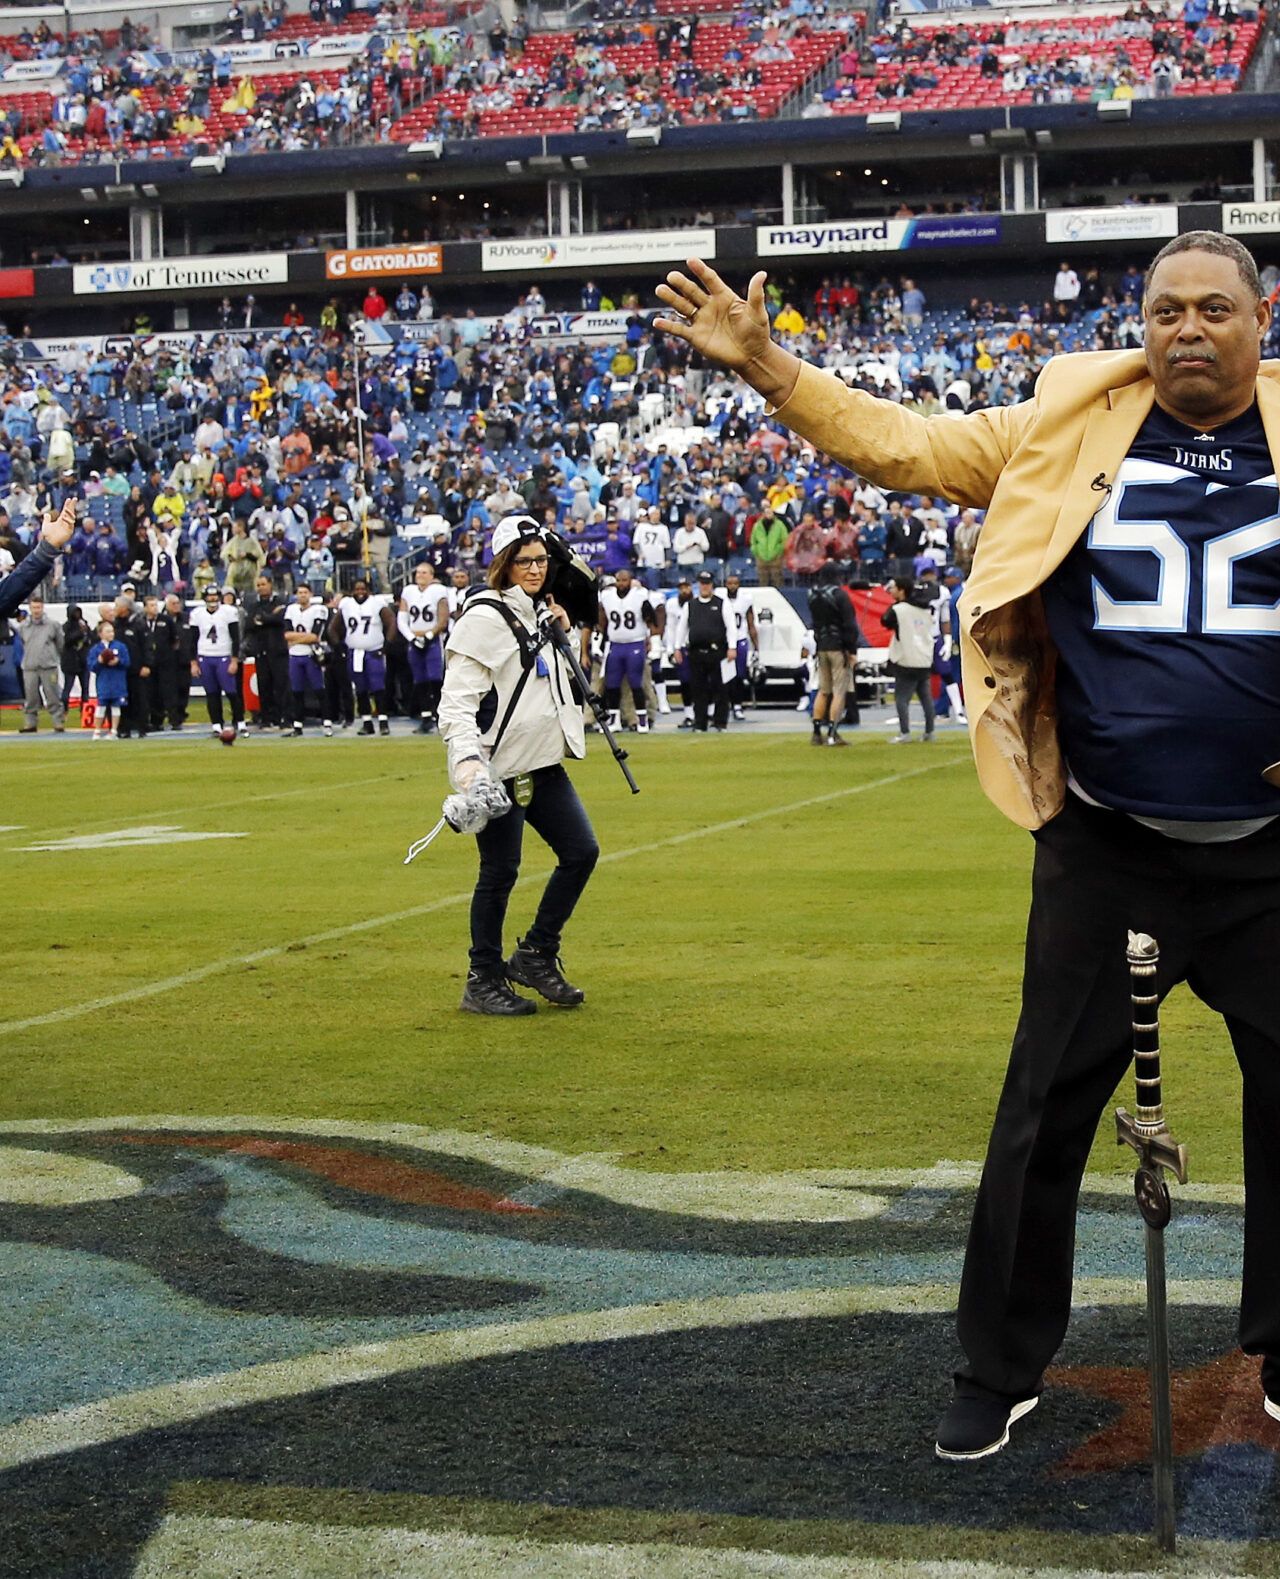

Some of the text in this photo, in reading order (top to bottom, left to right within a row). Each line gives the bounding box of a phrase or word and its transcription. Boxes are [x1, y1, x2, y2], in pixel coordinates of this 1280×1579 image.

[769, 220, 888, 257] maynard
[489, 242, 548, 258] RJYoung
[328, 251, 439, 276] G GATORADE
[132, 264, 270, 288] of Tennessee
[1169, 446, 1233, 471] TITANS
[409, 605, 434, 623] 96
[609, 610, 637, 631] 98
[206, 624, 218, 644] 4
[348, 616, 373, 635] 97
